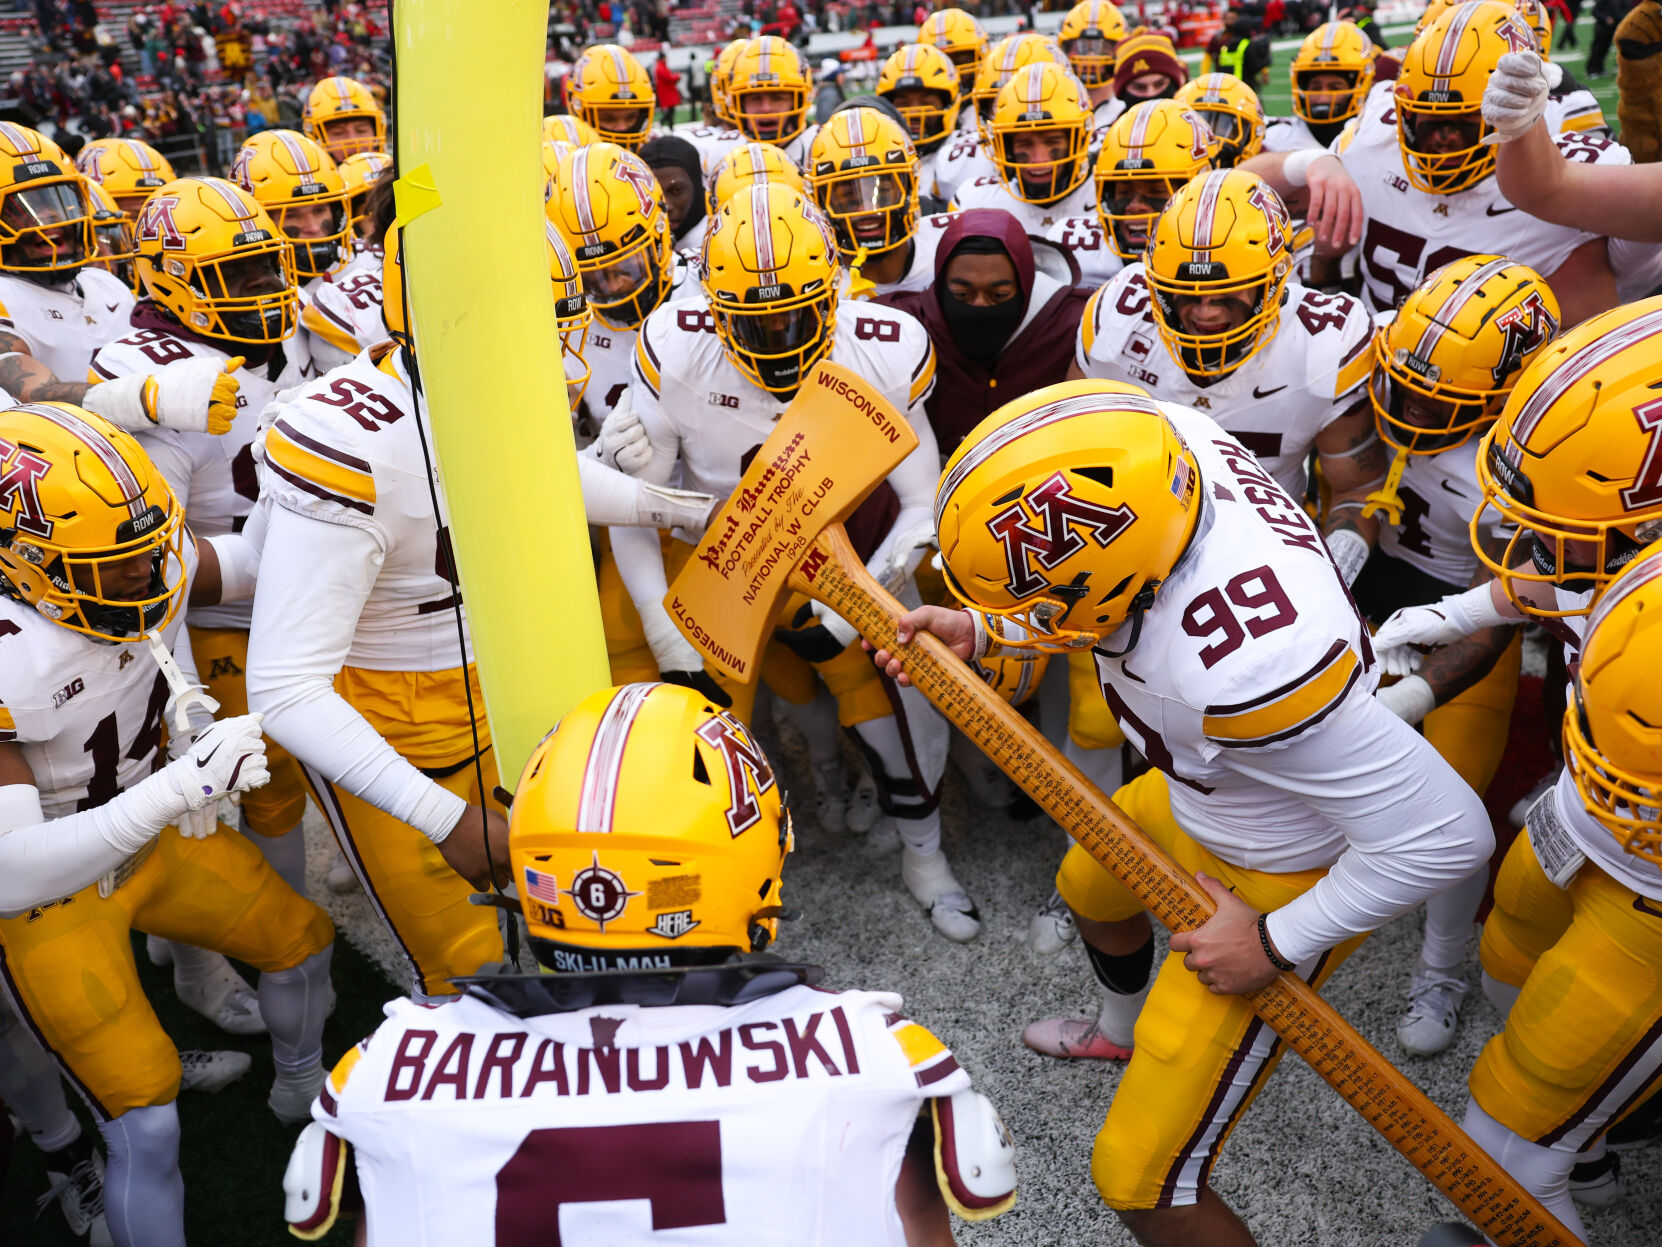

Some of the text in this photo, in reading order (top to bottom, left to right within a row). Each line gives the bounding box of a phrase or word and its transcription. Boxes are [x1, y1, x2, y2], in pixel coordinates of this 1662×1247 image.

[1189, 263, 1213, 276] ROW
[567, 298, 582, 312] ROW
[758, 285, 781, 299] ROW
[855, 317, 900, 344] 8
[1407, 357, 1429, 374] ROW
[306, 377, 405, 433] 52
[817, 370, 901, 444] WISCONSIN
[1495, 456, 1516, 486] ROW
[698, 431, 805, 573] Paul Bunyan
[720, 448, 812, 580] FOOTBALL TROPHY
[1210, 439, 1326, 559] KESICH
[132, 511, 155, 534] ROW
[985, 470, 1139, 600] M
[742, 476, 835, 606] NATIONAL W CLUB
[787, 535, 807, 561] 1948
[799, 547, 830, 583] M
[671, 596, 747, 674] MINNESOTA
[1181, 563, 1299, 671] 99
[589, 883, 605, 907] 6
[657, 910, 692, 938] HERE
[384, 1005, 861, 1102] BARANOWSKI
